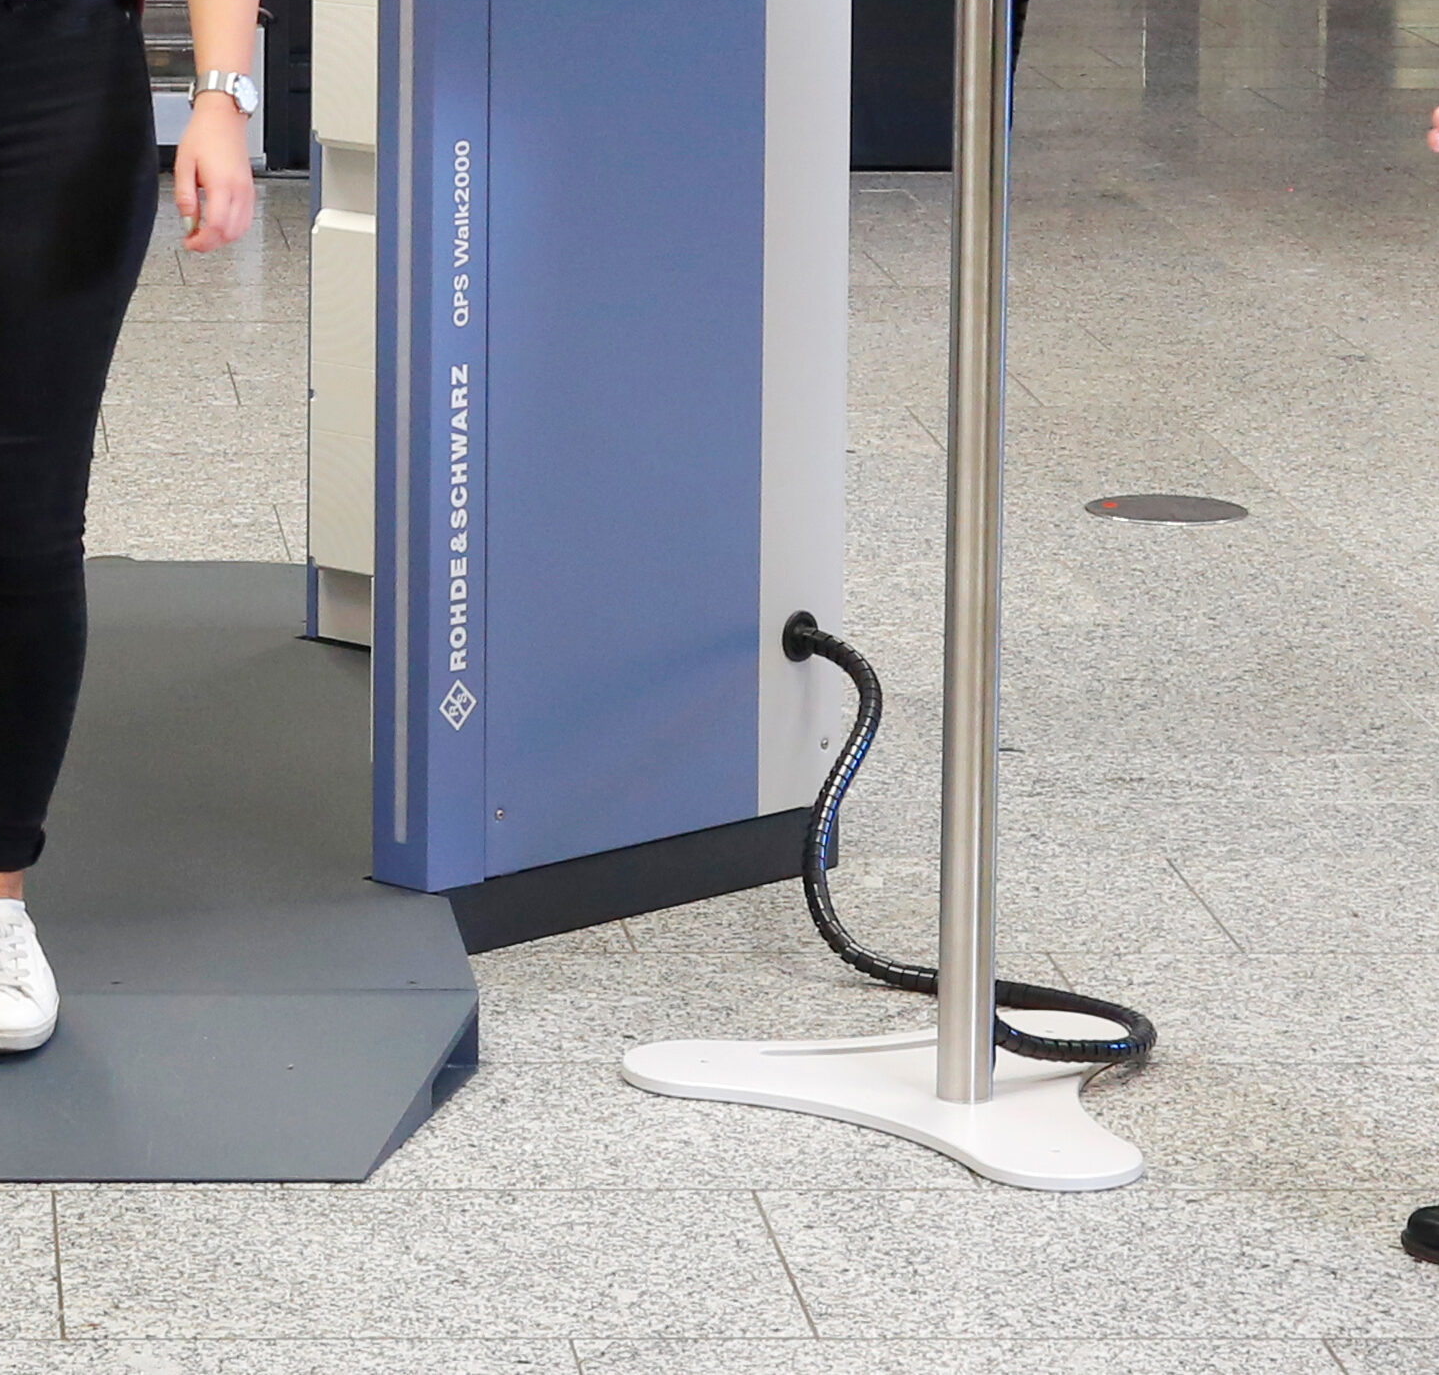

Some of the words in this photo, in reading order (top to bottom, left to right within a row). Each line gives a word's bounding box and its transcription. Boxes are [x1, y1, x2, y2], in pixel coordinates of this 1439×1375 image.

[454, 140, 471, 268] Walk2000
[453, 273, 469, 327] QPS
[450, 363, 469, 671] ROHDE&SCHWARZ
